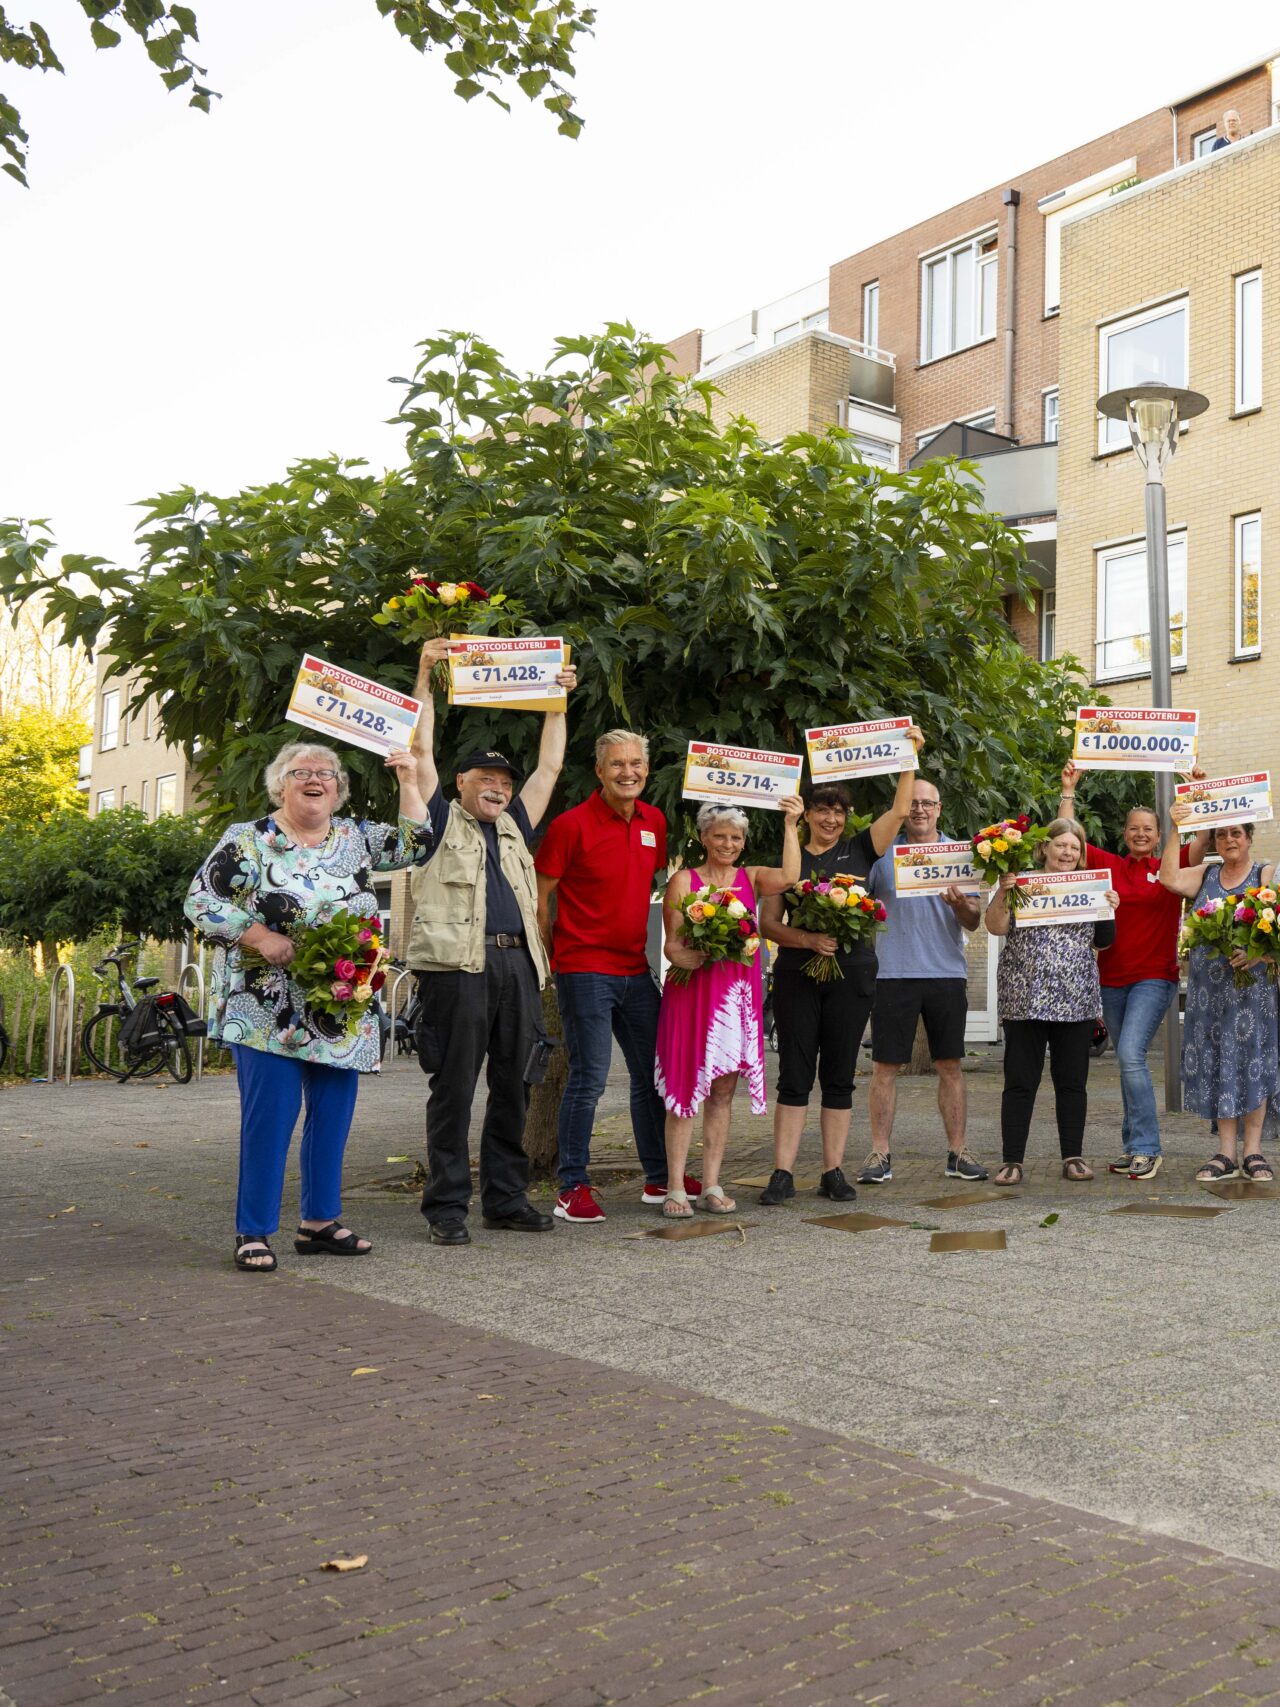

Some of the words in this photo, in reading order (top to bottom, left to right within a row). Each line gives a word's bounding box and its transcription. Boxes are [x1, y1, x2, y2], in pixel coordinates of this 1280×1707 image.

[466, 642, 512, 651] POSTCODE
[514, 641, 546, 650] LOTERIJ
[321, 666, 369, 692] POSTCODE
[369, 685, 404, 706] LOTERIJ
[1096, 710, 1143, 719] POSTCODE
[1144, 711, 1180, 720] LOTERIJ
[822, 725, 864, 737] POSTCODE
[865, 721, 896, 732] LOTERIJ
[706, 746, 752, 759] POSTCODE
[752, 753, 785, 764] LOTERIJ
[1189, 781, 1227, 791] POSTCODE
[1227, 776, 1255, 786] LOTERIJ
[909, 846, 949, 854] POSTCODE
[1028, 875, 1067, 885] POSTCODE
[1067, 873, 1096, 881] LOTERIJ
